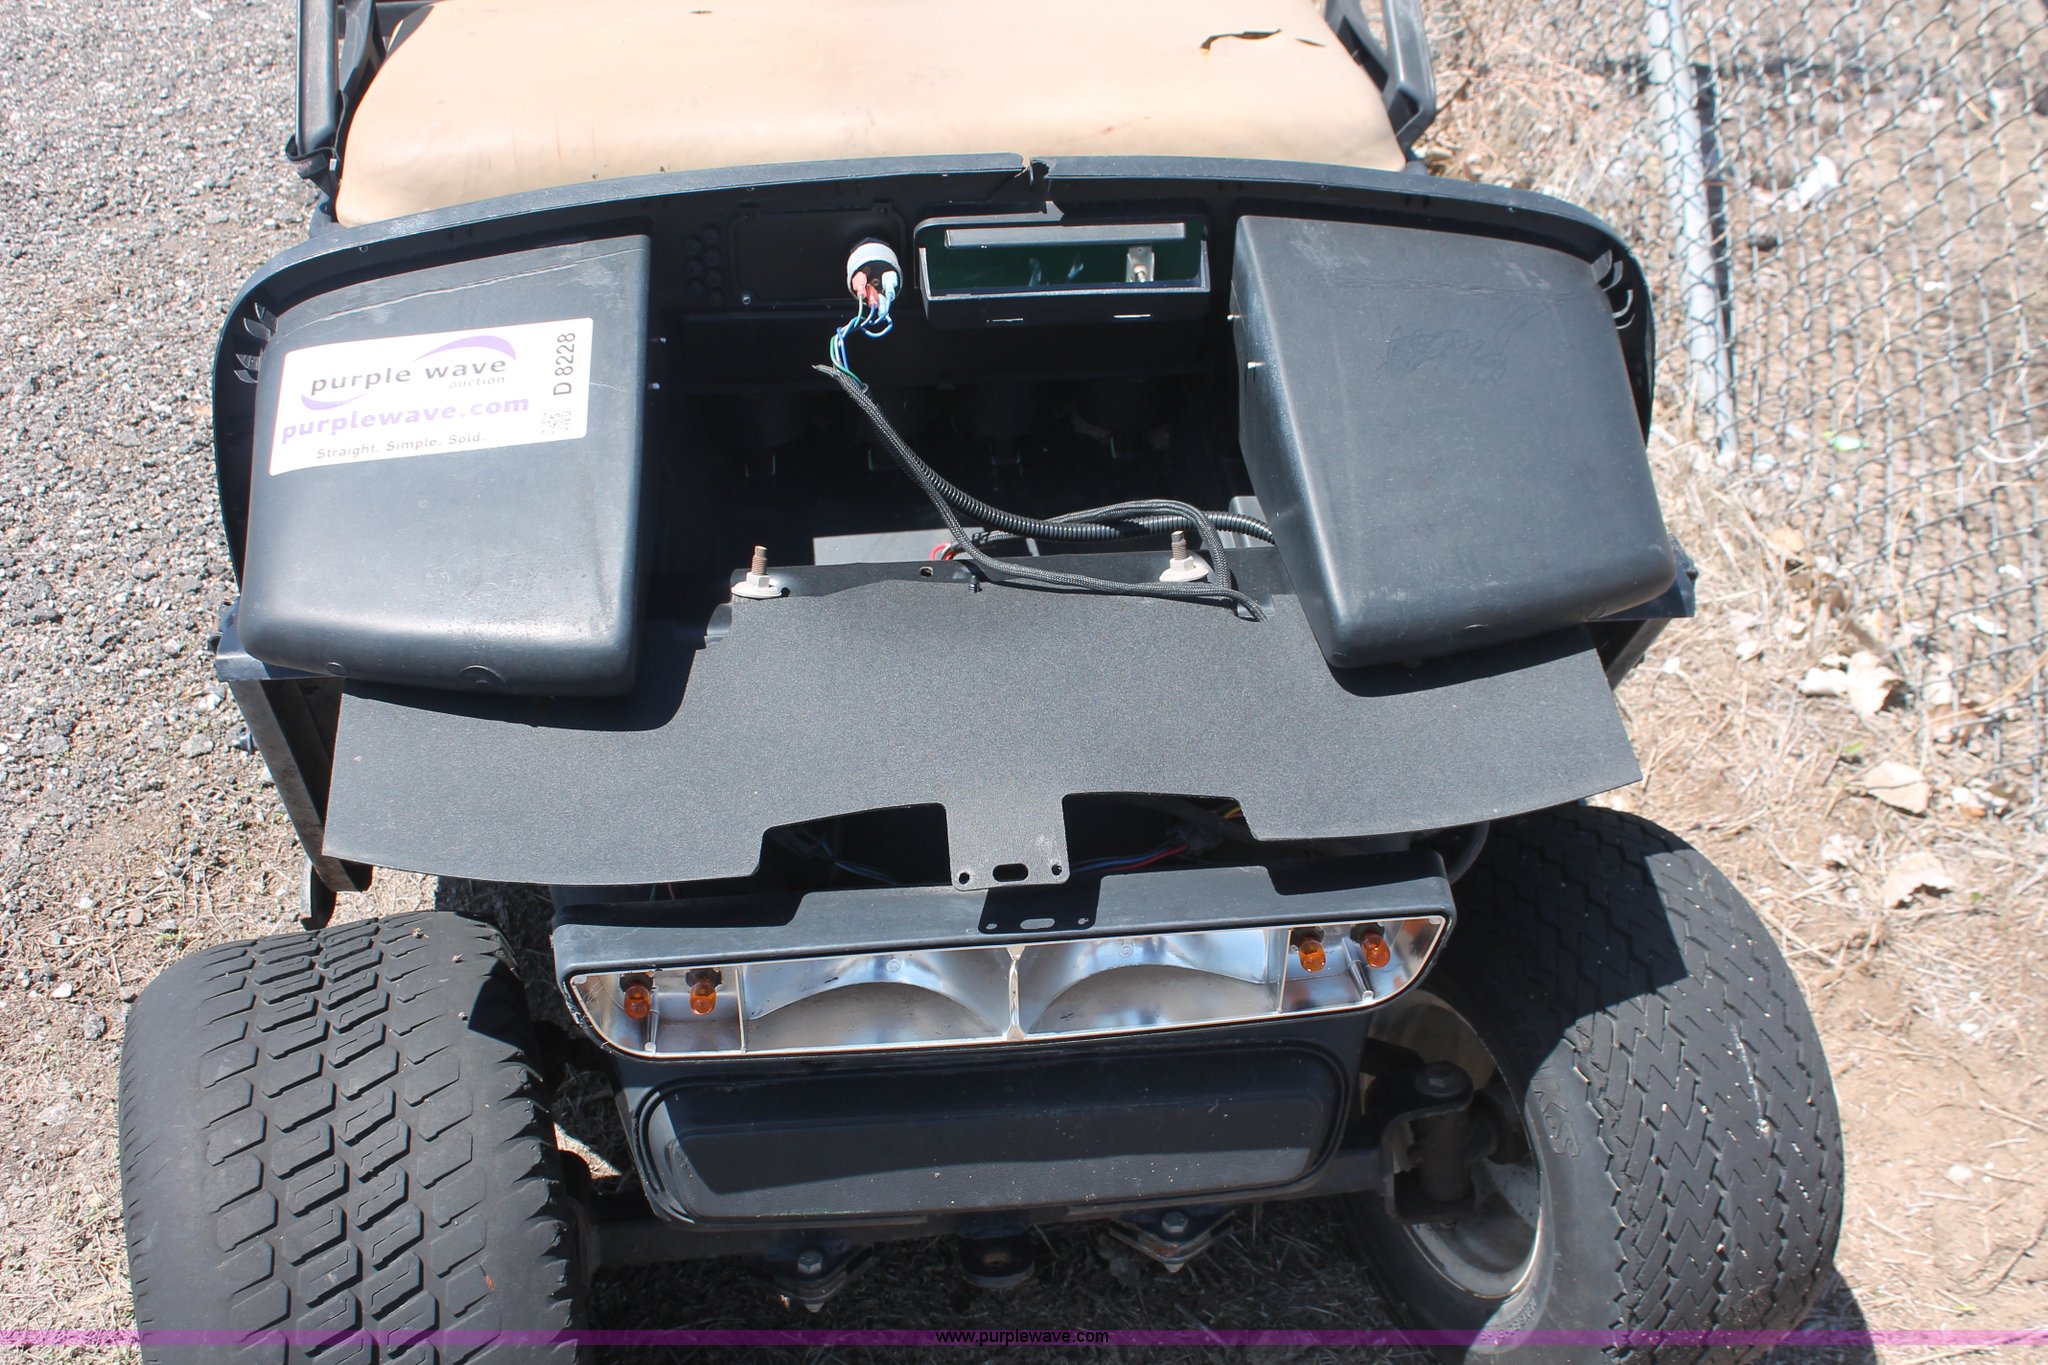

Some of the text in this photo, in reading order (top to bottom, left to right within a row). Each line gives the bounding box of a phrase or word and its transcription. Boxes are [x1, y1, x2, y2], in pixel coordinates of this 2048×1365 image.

[310, 359, 507, 396] purple wave
[552, 332, 576, 396] D 8228
[281, 397, 529, 444] purplewave.com
[316, 431, 485, 460] Straight. Simple. Sold.
